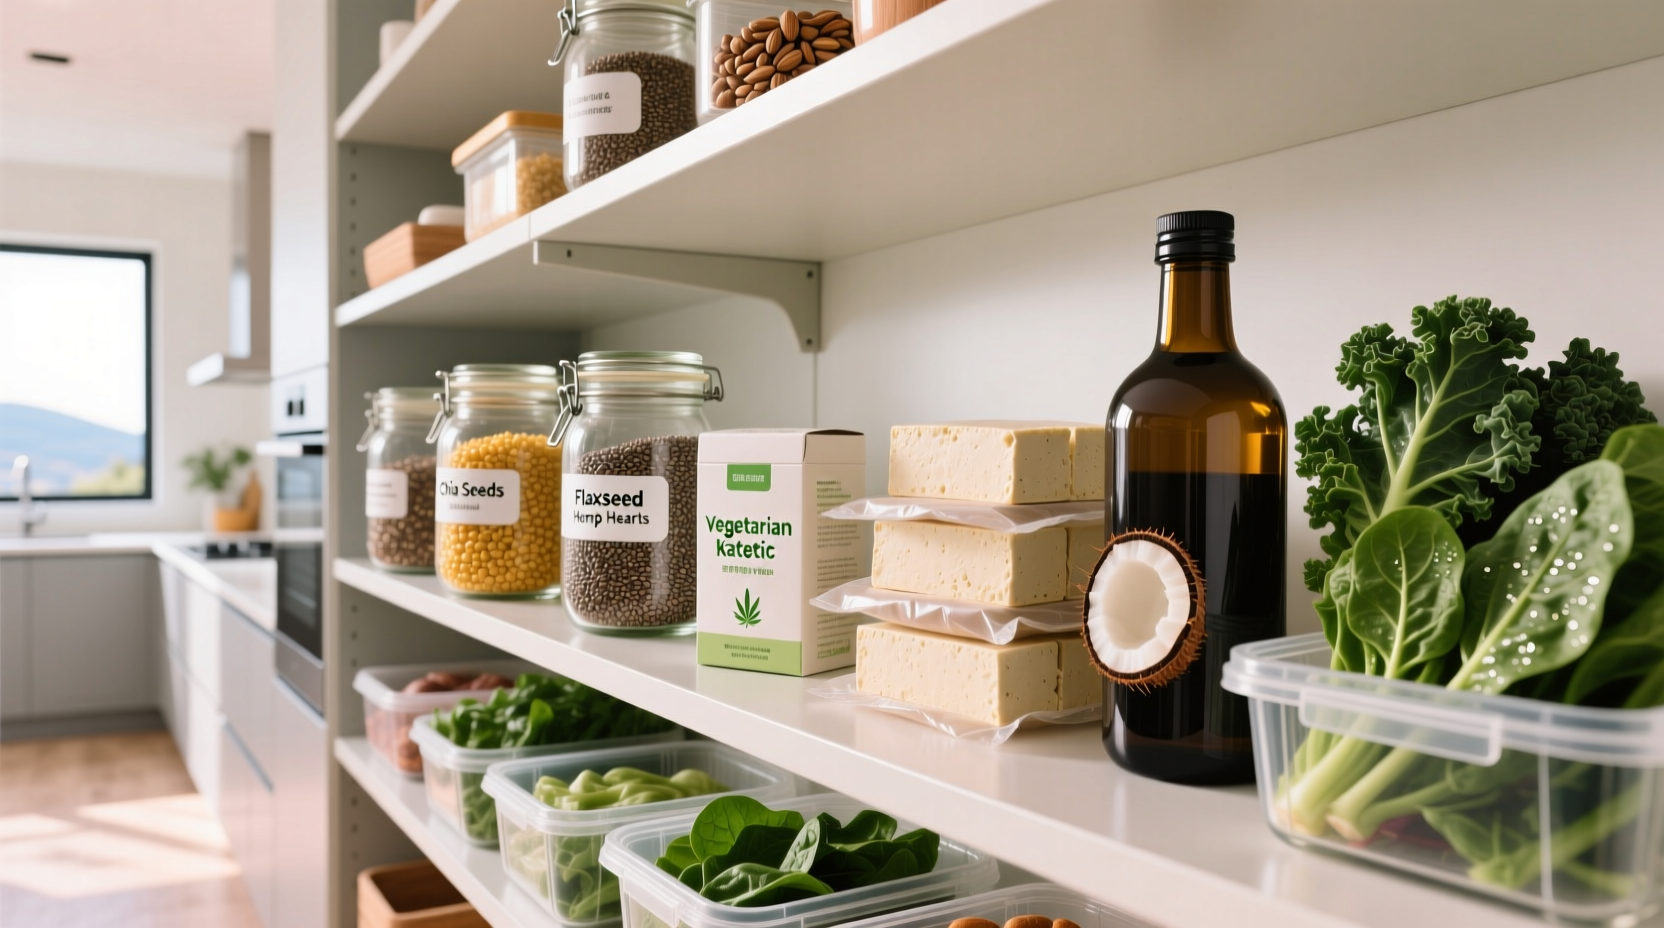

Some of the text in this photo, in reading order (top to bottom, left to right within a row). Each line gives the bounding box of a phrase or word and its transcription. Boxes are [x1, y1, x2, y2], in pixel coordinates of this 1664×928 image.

[462, 482, 505, 497] Seeds
[575, 489, 643, 507] Flaxseed
[607, 511, 649, 525] Hearts
[706, 515, 792, 538] Vegetarian
[716, 539, 775, 559] Katetic
